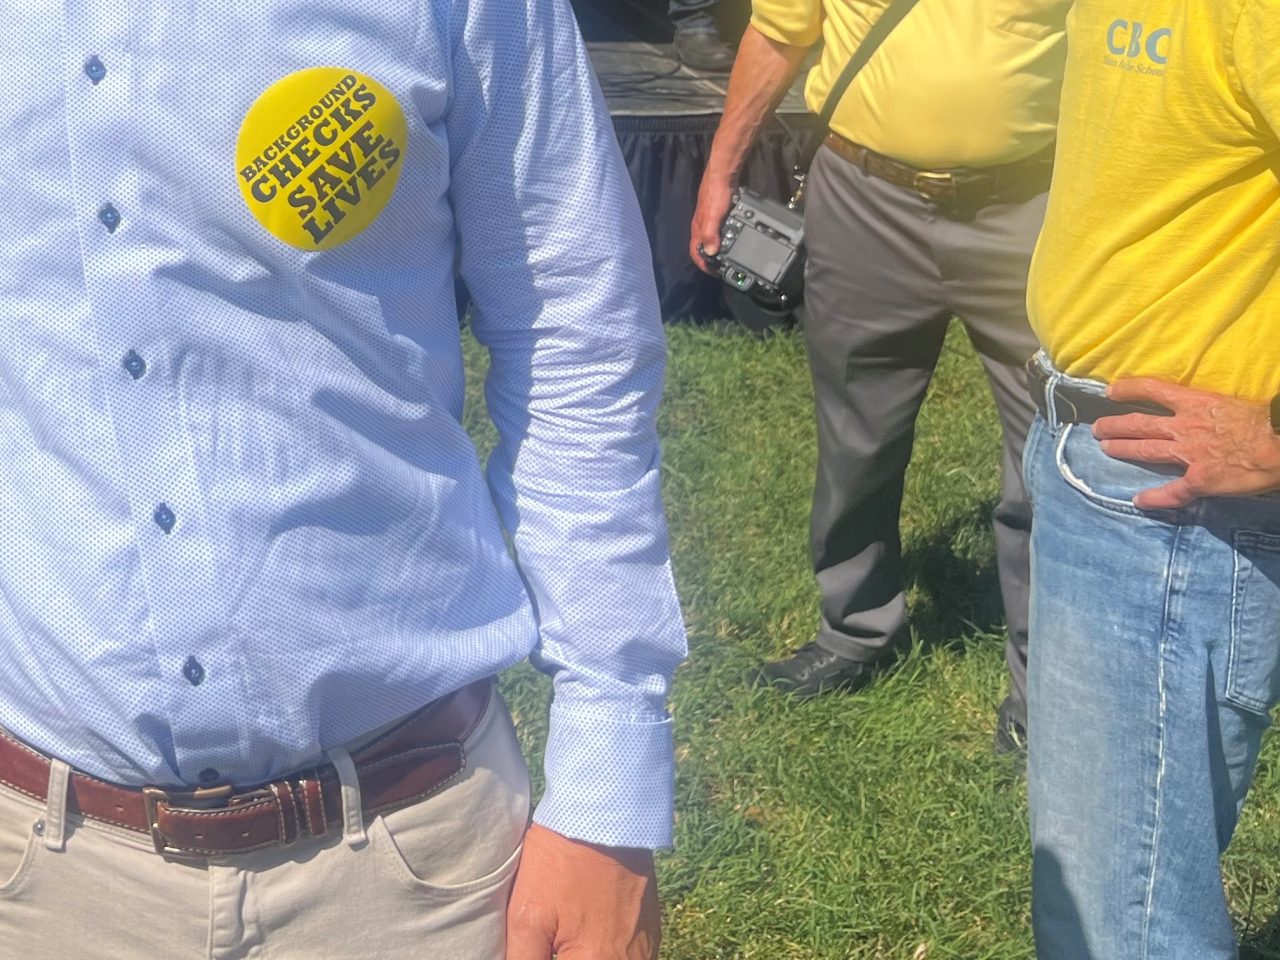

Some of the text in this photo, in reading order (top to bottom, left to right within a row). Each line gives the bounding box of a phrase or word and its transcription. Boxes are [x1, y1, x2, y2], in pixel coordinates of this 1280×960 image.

[1106, 19, 1172, 63] CBC
[239, 74, 357, 183] BACKGROUND
[250, 83, 377, 203] CHECKS
[287, 119, 385, 220] SAVE
[301, 137, 401, 245] LIVES
